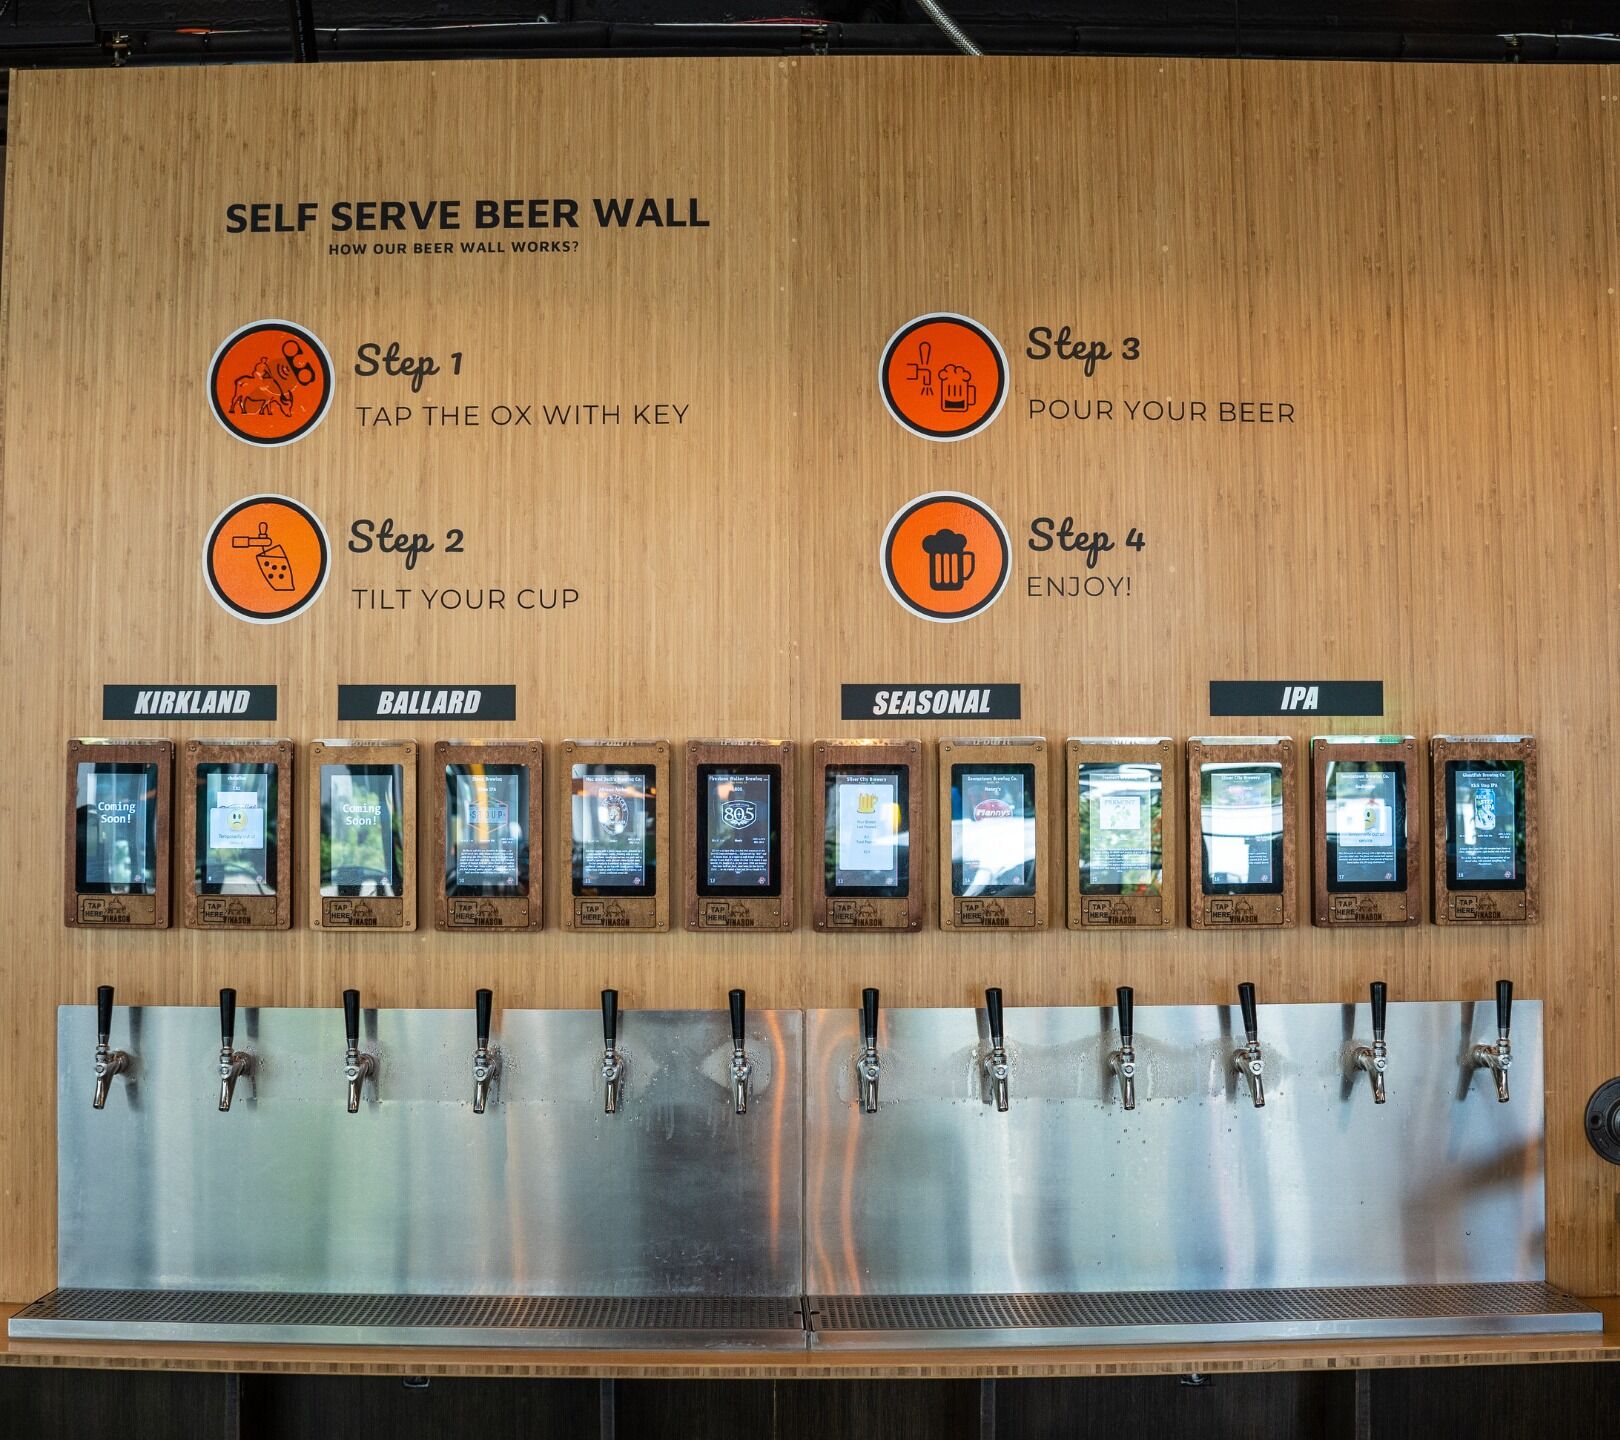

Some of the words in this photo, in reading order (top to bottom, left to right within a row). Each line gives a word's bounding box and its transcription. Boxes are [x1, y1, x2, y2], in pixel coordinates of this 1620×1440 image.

[226, 202, 319, 234] SELF
[331, 199, 461, 232] SERVE
[475, 198, 580, 230] BEER
[591, 197, 711, 228] WALL
[328, 243, 368, 256] HOW
[372, 242, 407, 255] OUR
[413, 242, 454, 255] BEER
[459, 241, 506, 254] WALL
[510, 240, 579, 253] WORKS?
[1026, 325, 1113, 378] Step
[1121, 336, 1140, 361] 3
[354, 341, 441, 394] Step
[450, 351, 463, 376] 1
[355, 406, 412, 427] TAP
[421, 405, 480, 426] THE
[491, 405, 532, 426] OX
[542, 404, 620, 425] WITH
[634, 404, 689, 425] KEY
[1029, 399, 1113, 420] POUR
[1123, 400, 1207, 422] YOUR
[1219, 401, 1295, 423] BEER
[348, 518, 435, 571] Step
[444, 528, 464, 553] 2
[1028, 516, 1115, 570] Step
[1125, 527, 1146, 552] 4
[1027, 576, 1131, 597] ENJOY!
[351, 589, 412, 610] TILT
[421, 589, 506, 610] YOUR
[517, 588, 579, 610] CUP
[133, 689, 251, 715] KIRKLAND
[376, 689, 482, 715] BALLARD
[872, 688, 991, 716] SEASONAL
[1280, 685, 1320, 711] IPA
[98, 801, 136, 813] Coming
[101, 814, 131, 824] Soon!
[343, 804, 381, 815] Coming
[724, 807, 755, 821] 805
[345, 816, 377, 826] Soon!
